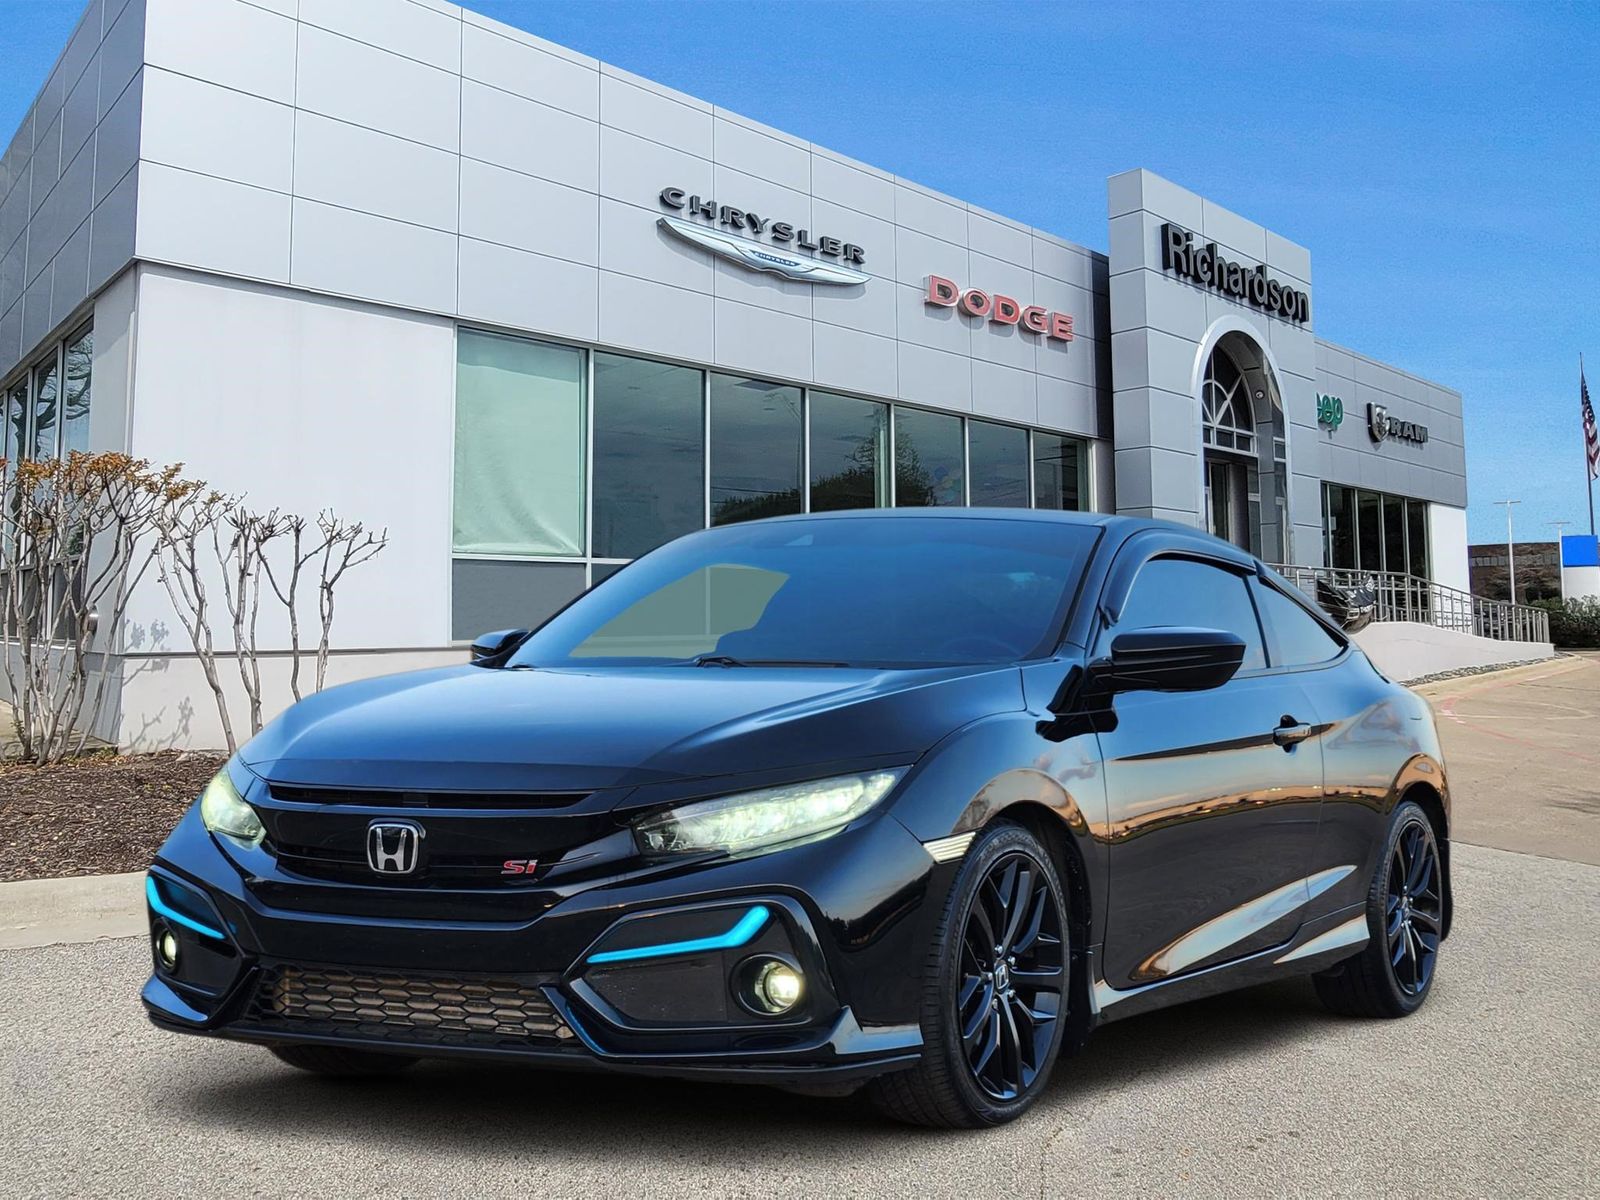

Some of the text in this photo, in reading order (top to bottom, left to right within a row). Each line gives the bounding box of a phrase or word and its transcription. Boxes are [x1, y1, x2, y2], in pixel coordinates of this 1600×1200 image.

[658, 187, 866, 264] CHRYSLER
[924, 273, 1074, 343] DODGE
[1161, 223, 1310, 323] Richardson
[1386, 416, 1429, 443] RAM
